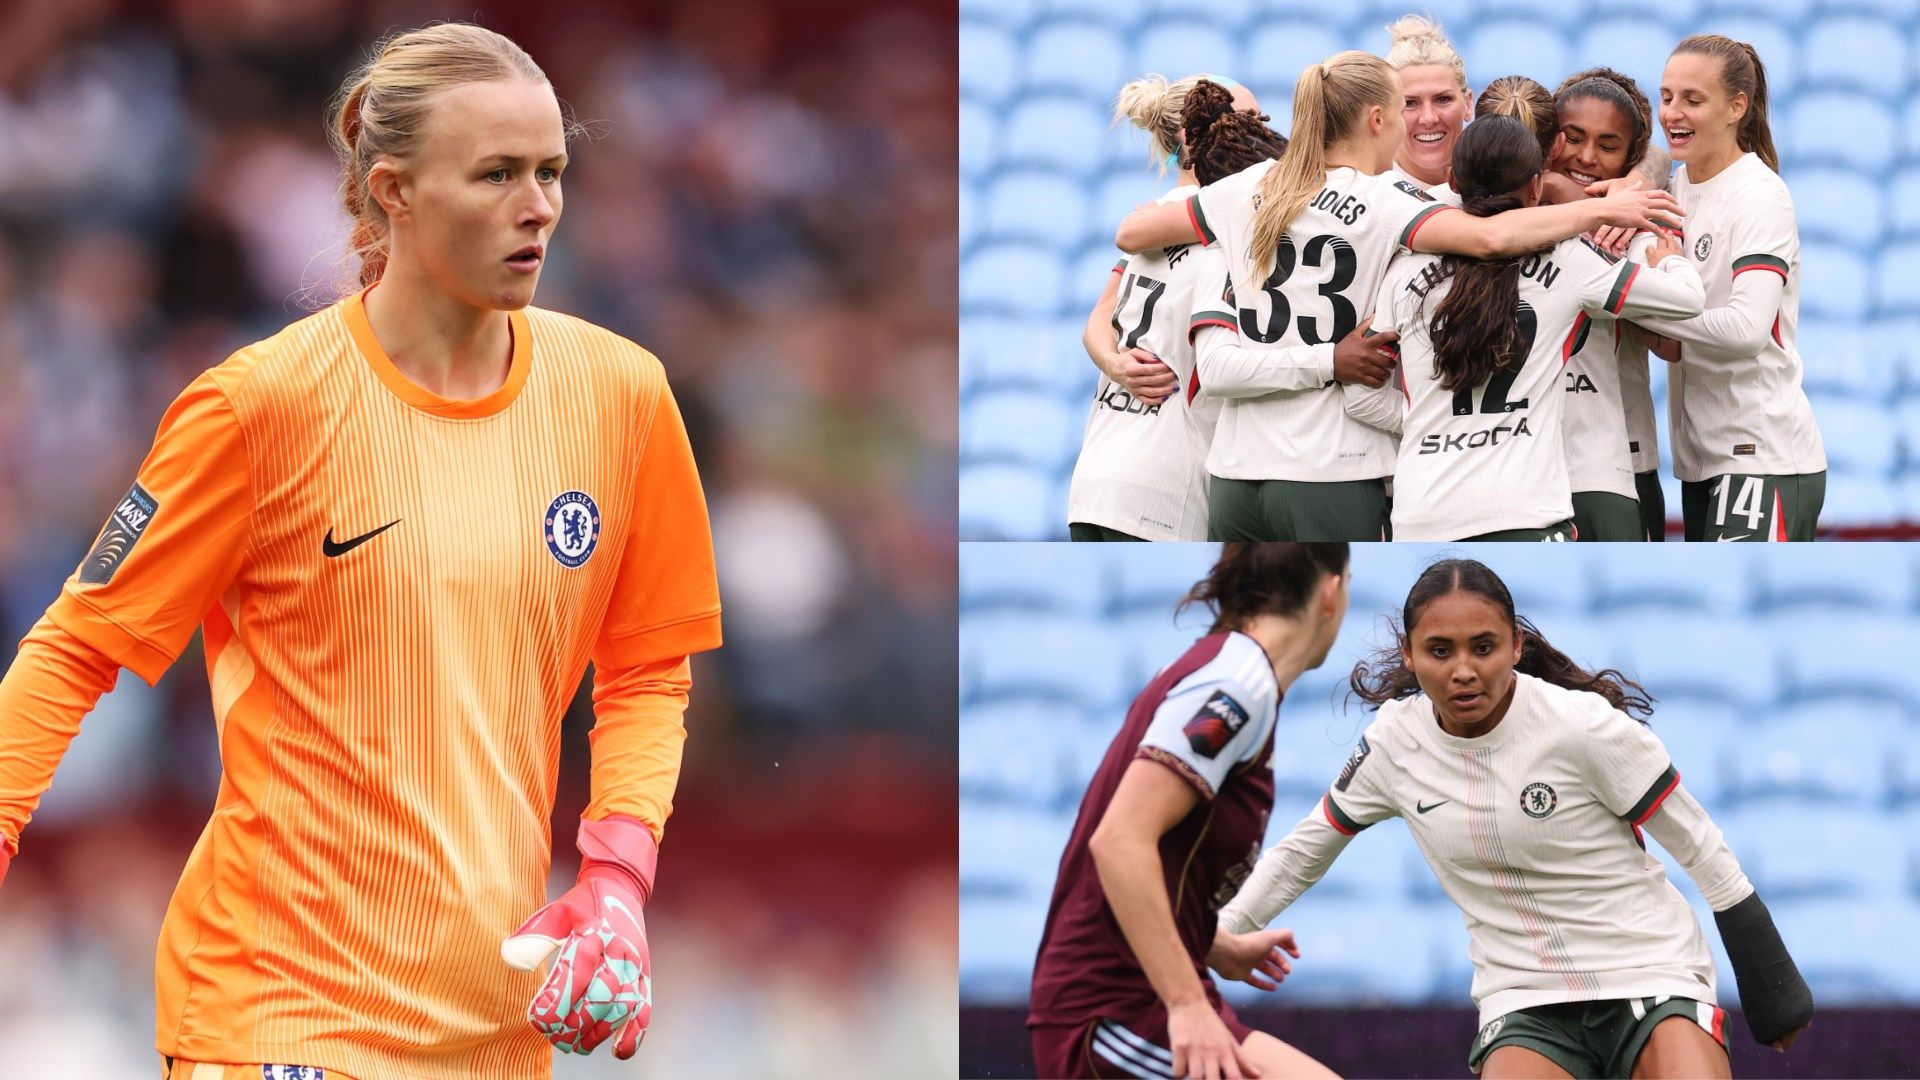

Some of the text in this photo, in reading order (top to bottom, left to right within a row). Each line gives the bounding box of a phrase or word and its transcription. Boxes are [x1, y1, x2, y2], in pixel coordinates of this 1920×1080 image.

[1239, 232, 1358, 347] 33
[1405, 252, 1561, 298] THOON
[1111, 273, 1167, 348] 17
[117, 498, 148, 531] WSL
[553, 493, 592, 510] CHELSEA
[1713, 474, 1764, 530] 14
